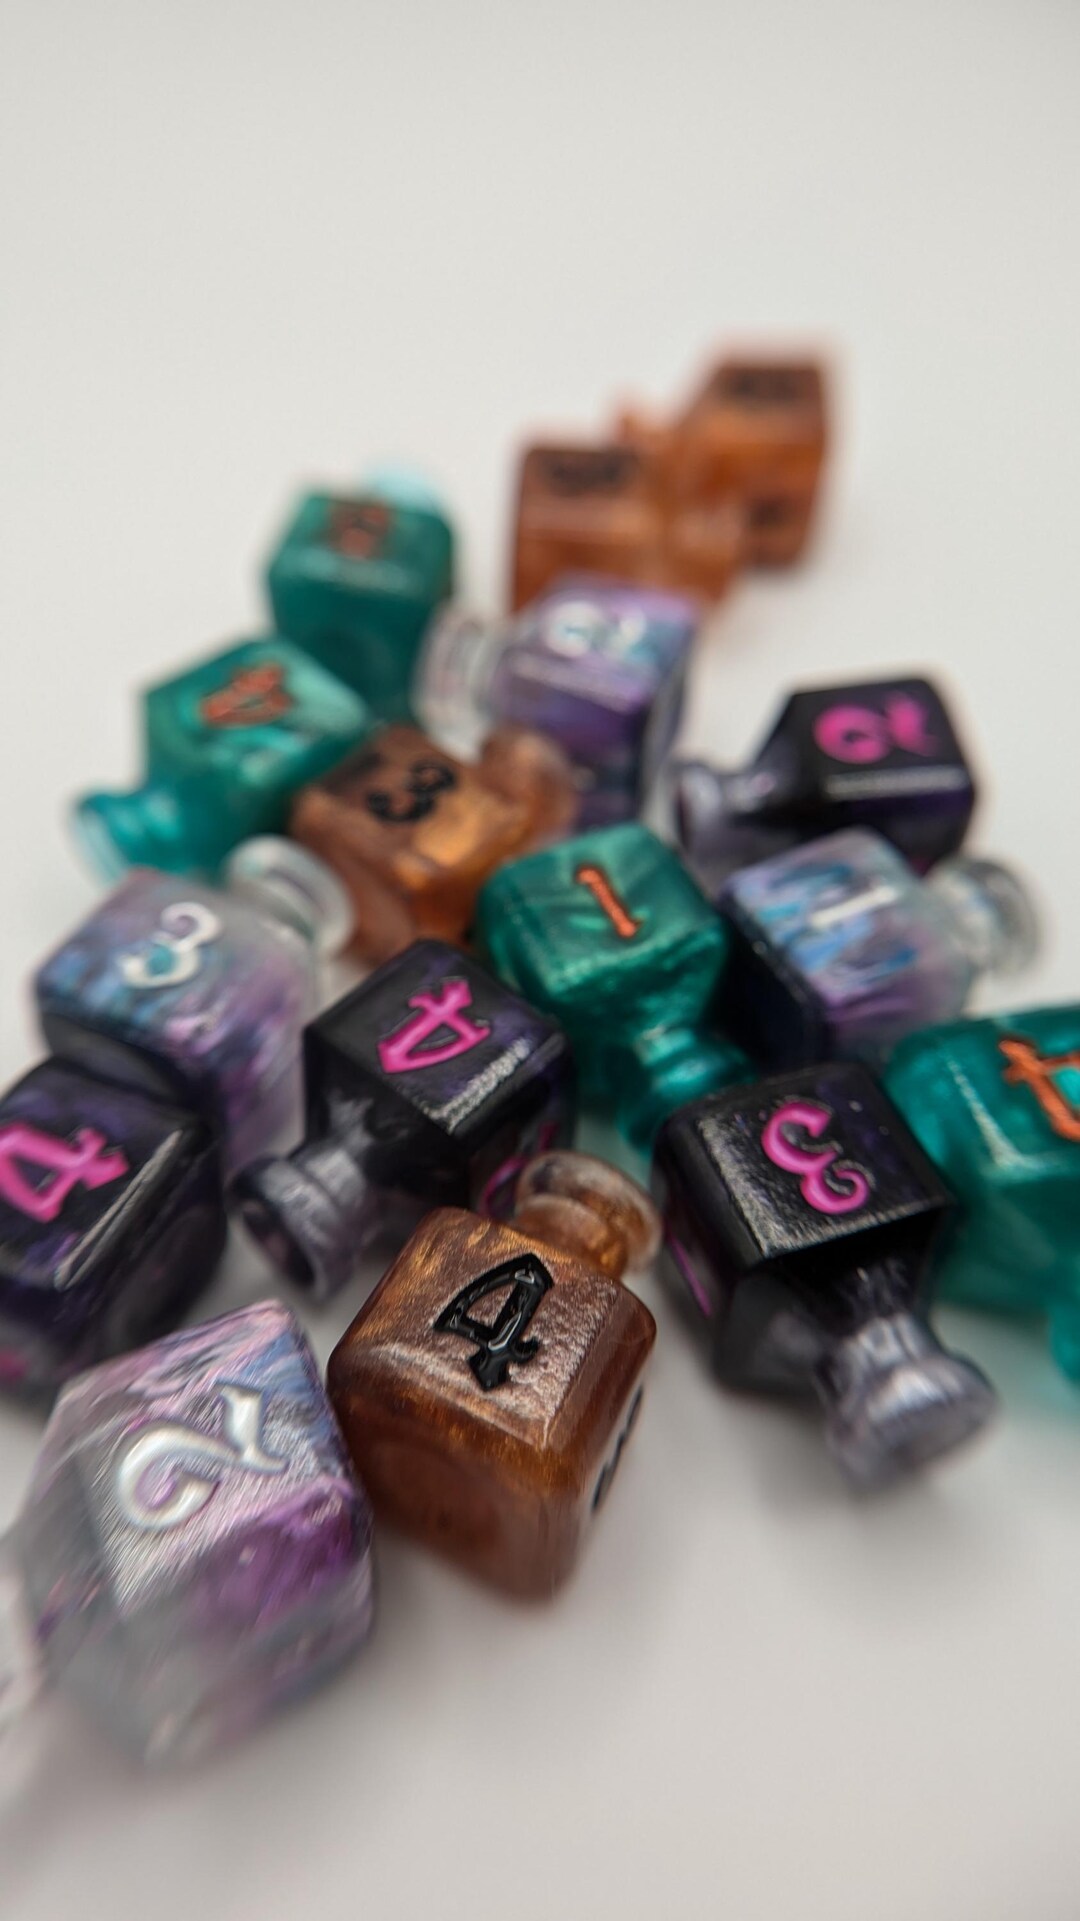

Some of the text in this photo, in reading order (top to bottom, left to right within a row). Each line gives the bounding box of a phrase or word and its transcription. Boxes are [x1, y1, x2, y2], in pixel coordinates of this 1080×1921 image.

[365, 758, 458, 825] 3
[120, 900, 222, 989] 3
[576, 863, 643, 938] 1
[376, 976, 492, 1075] 4
[0, 1120, 129, 1223] 4
[762, 1100, 870, 1215] 3
[433, 1252, 555, 1393] 4
[116, 1380, 290, 1532] 2
